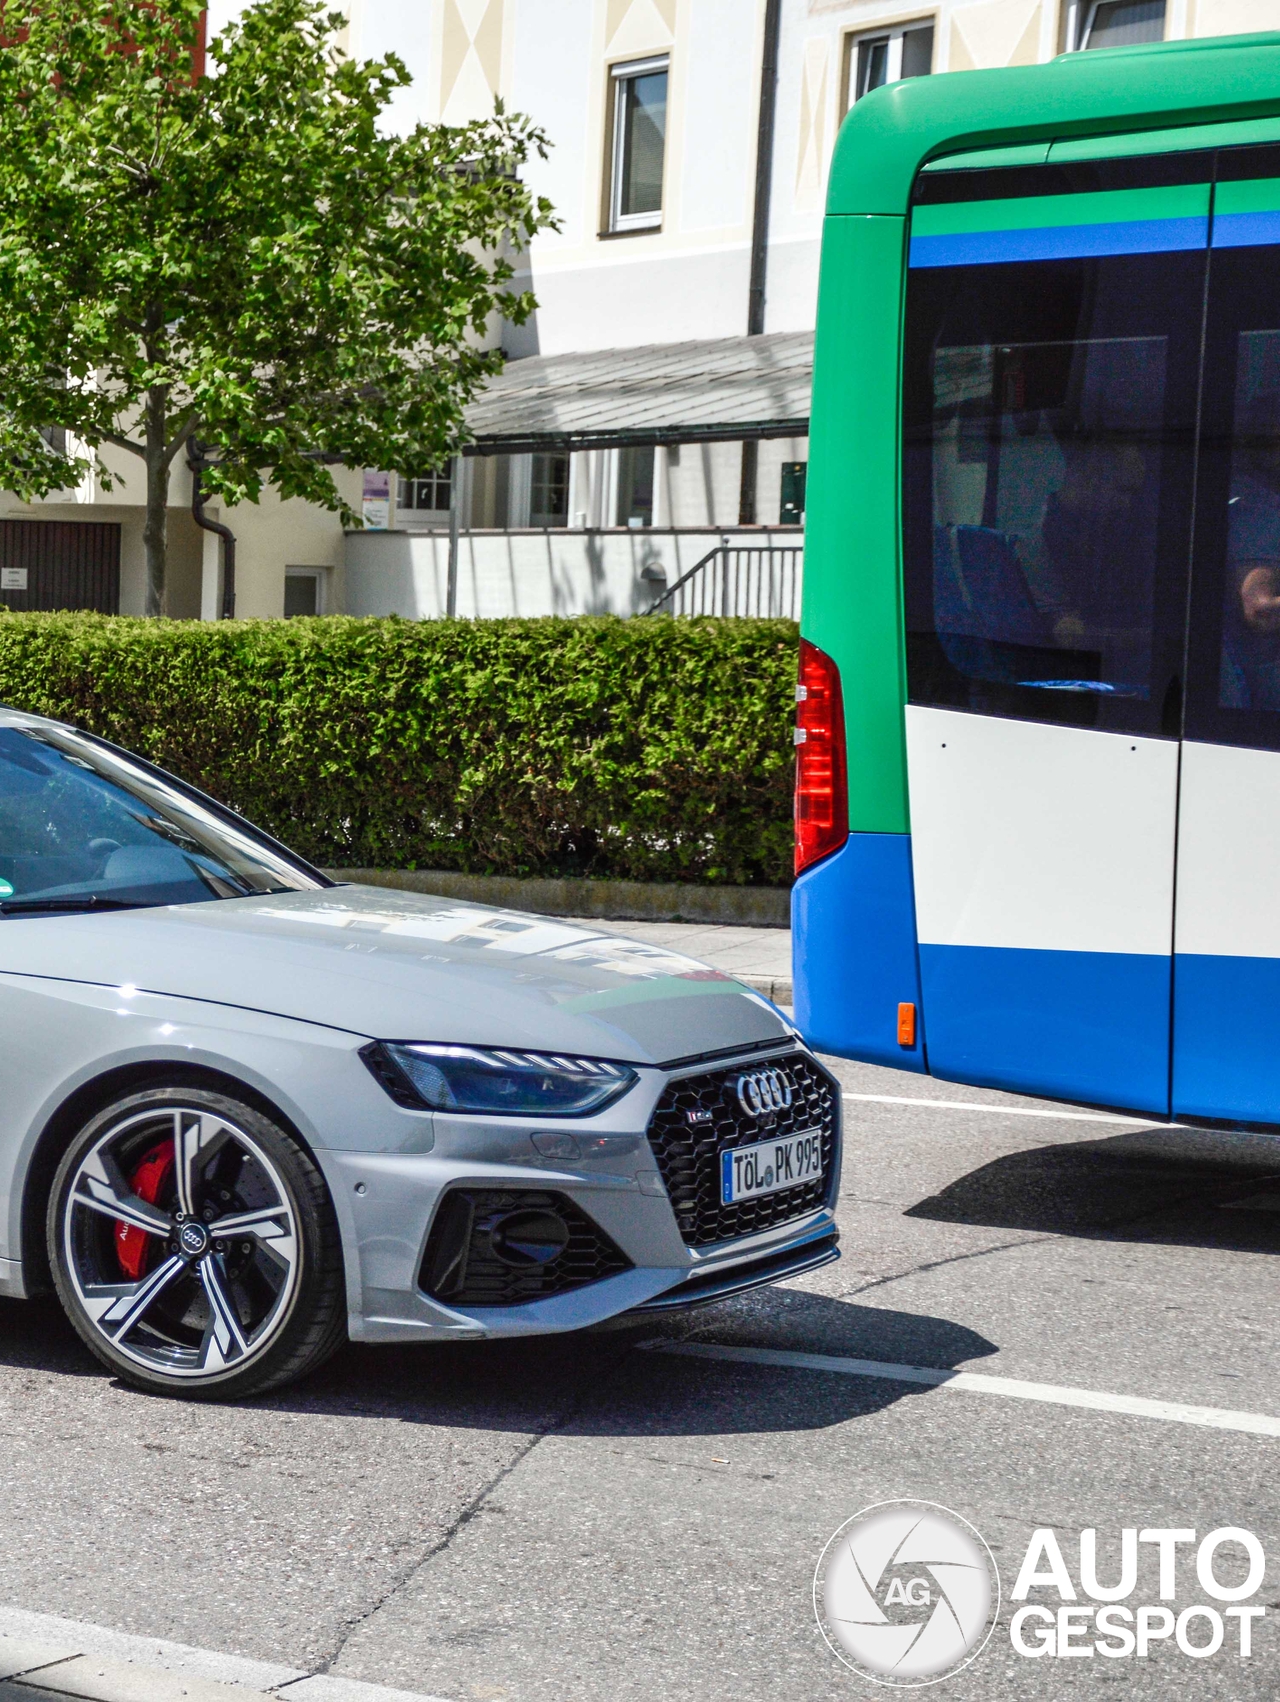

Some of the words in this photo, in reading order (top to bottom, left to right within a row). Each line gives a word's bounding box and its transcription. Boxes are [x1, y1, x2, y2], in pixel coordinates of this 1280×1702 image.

[734, 1151, 764, 1193] TÖL
[775, 1143, 794, 1183] PK
[796, 1135, 820, 1177] 995
